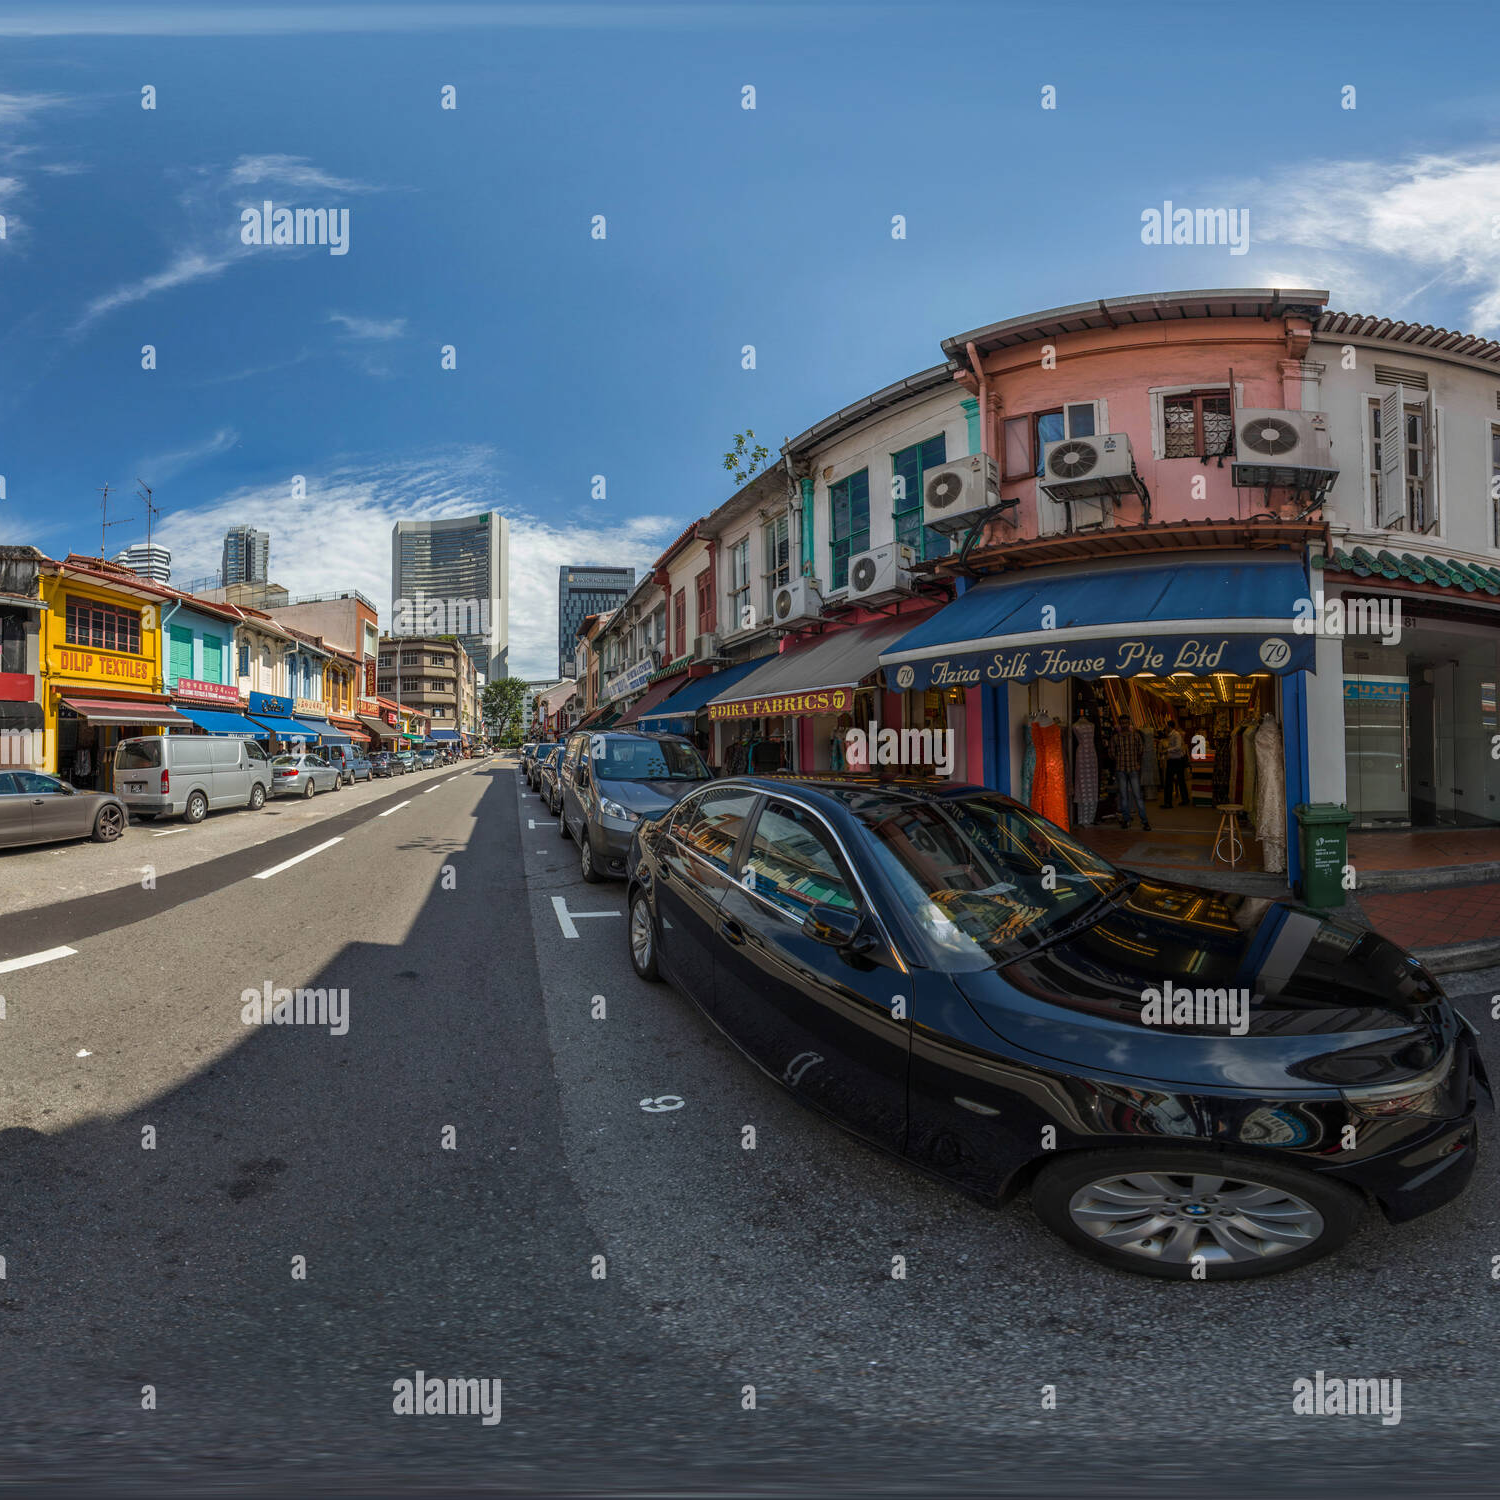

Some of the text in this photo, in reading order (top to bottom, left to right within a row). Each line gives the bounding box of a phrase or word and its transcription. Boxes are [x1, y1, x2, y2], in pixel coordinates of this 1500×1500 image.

[1404, 617, 1417, 628] 81
[931, 640, 1229, 685] Aziza Silk House Pte Ltd
[1265, 644, 1288, 662] 79
[60, 650, 148, 679] DILIP TEXTILES
[900, 669, 913, 684] 79
[718, 693, 829, 717] DIRA FABRICS
